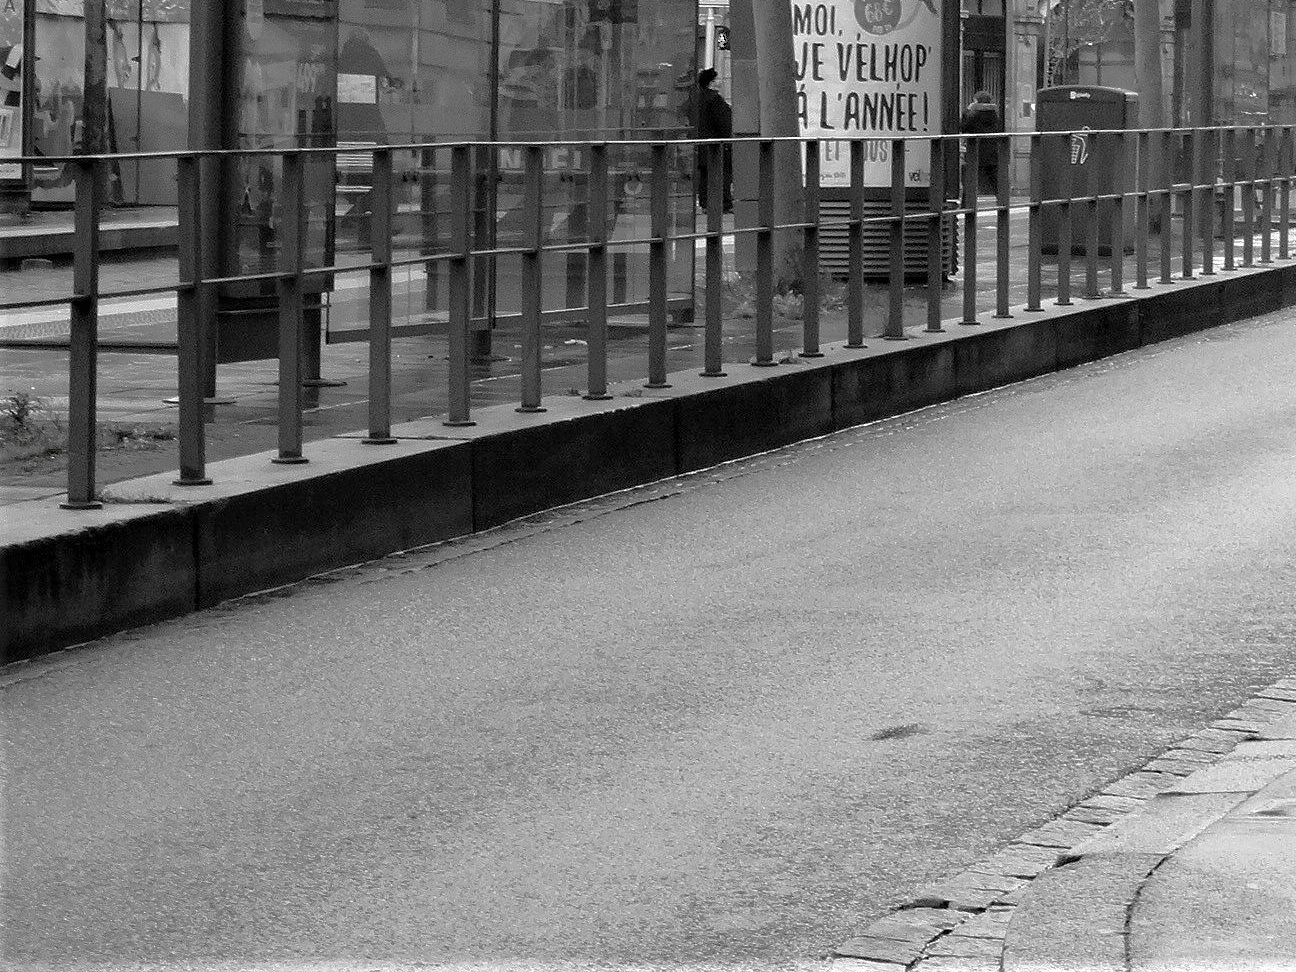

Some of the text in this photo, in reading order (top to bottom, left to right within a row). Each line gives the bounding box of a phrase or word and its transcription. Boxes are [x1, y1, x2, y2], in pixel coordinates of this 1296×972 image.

[793, 4, 842, 37] MOI,
[793, 33, 931, 83] JE VÉLHOP'
